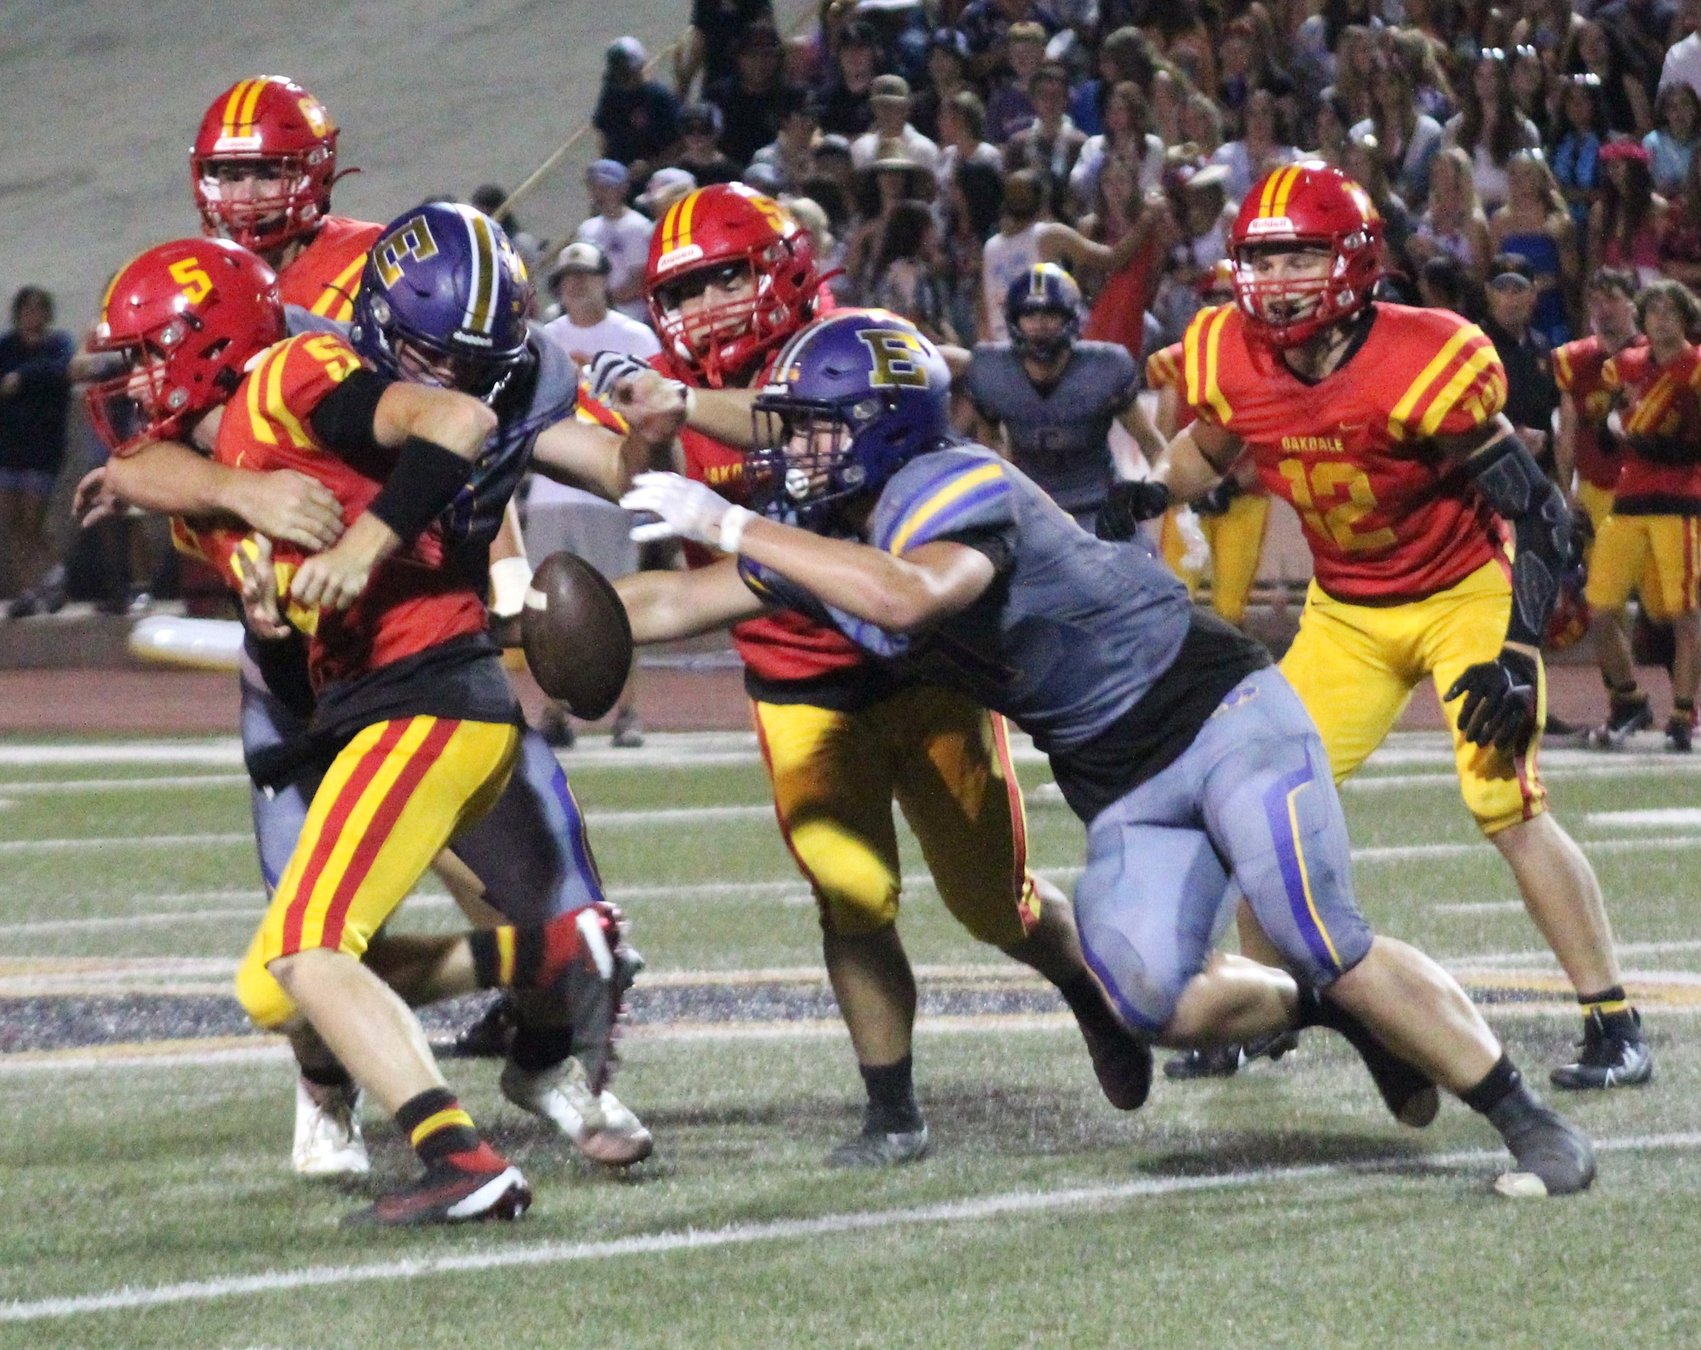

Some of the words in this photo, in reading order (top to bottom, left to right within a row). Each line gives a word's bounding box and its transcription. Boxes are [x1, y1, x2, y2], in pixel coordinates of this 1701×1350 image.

[373, 214, 439, 290] E
[168, 257, 214, 304] 5
[302, 335, 361, 383] 5
[855, 328, 930, 389] E
[1281, 435, 1345, 452] OAKDALE
[1278, 458, 1398, 552] 12
